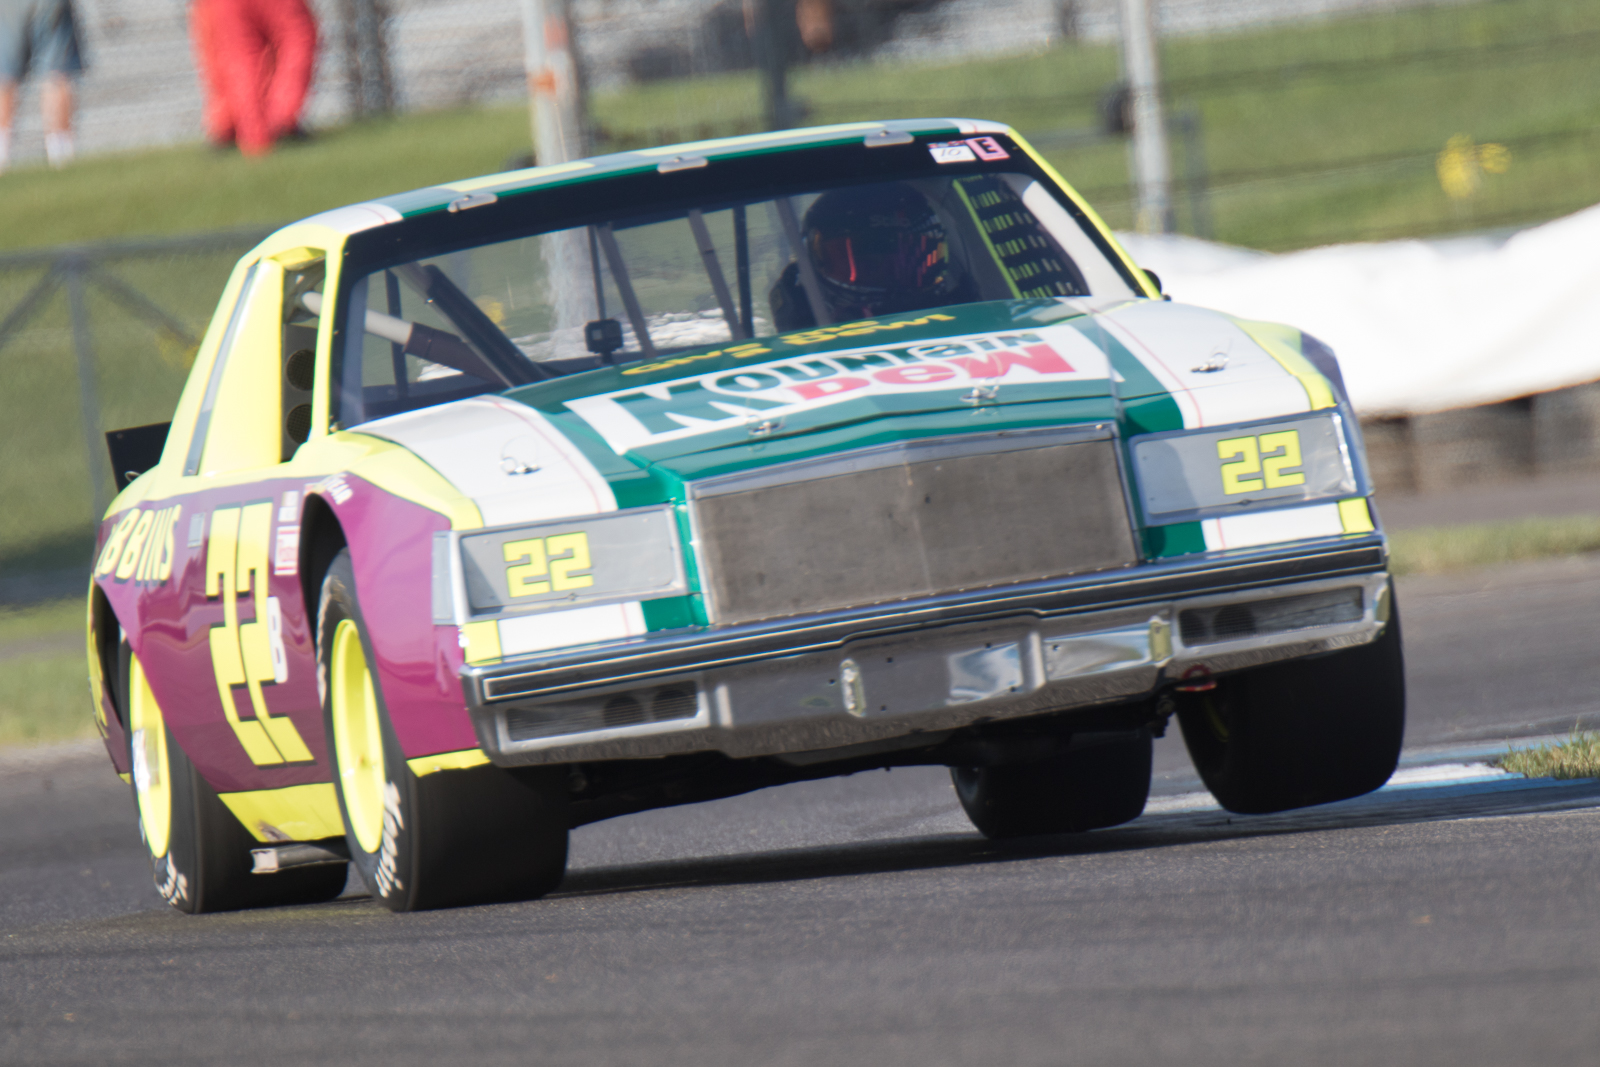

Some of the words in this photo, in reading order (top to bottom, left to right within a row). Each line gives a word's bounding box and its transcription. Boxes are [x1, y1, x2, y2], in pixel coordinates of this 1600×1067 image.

[1216, 429, 1306, 495] 22
[94, 503, 182, 582] BBINS
[502, 531, 594, 598] 22
[205, 501, 315, 766] 22
